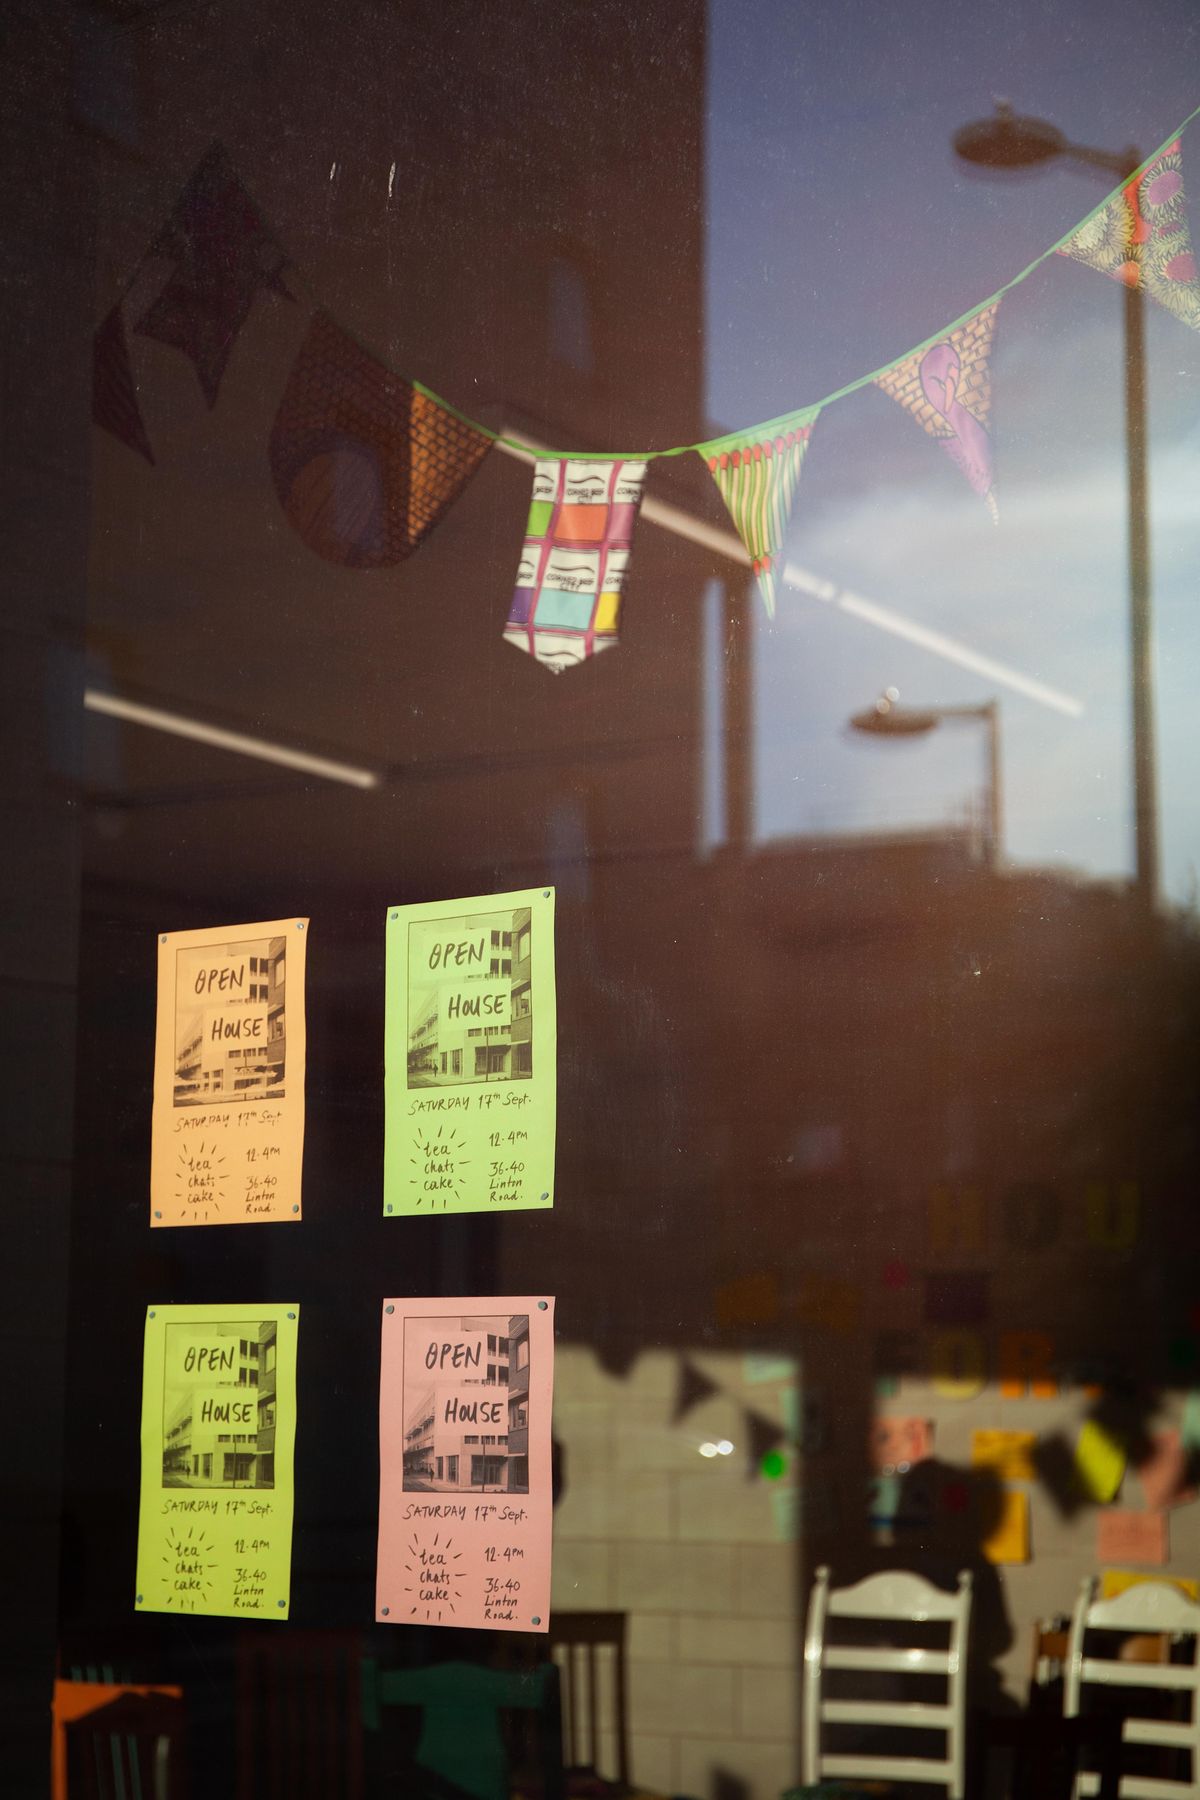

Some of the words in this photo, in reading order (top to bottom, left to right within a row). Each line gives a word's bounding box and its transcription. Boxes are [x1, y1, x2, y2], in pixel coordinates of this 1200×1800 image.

[428, 938, 485, 970] OPEN
[194, 964, 245, 995] OPEN
[448, 993, 507, 1019] HOUSE
[211, 1017, 264, 1041] HOUSE
[407, 1096, 470, 1116] SATURDAY
[478, 1093, 501, 1110] 17th
[502, 1091, 532, 1109] Sept.
[423, 1141, 451, 1158] tea
[187, 1156, 213, 1172] tea
[424, 1159, 454, 1175] chats
[423, 1176, 454, 1191] cake
[489, 1176, 523, 1190] Linton
[187, 1190, 214, 1204] cake
[245, 1190, 275, 1203] Linton
[184, 1345, 235, 1373] OPEN
[425, 1341, 482, 1370] OPEN
[201, 1398, 254, 1424] HOUSE
[444, 1397, 504, 1424] HOUSE
[161, 1499, 218, 1515] SATURDAY
[247, 1500, 274, 1519] Sept.
[402, 1503, 467, 1521] SATURDAY
[474, 1504, 497, 1522] 17th
[498, 1506, 528, 1526] Sept.
[175, 1541, 200, 1558] tea
[419, 1548, 447, 1566] tea
[175, 1560, 203, 1576] chats
[419, 1568, 451, 1585] chats
[174, 1577, 202, 1591] cake
[233, 1584, 265, 1596] Linton
[419, 1586, 450, 1601] cake
[484, 1593, 519, 1607] Linton
